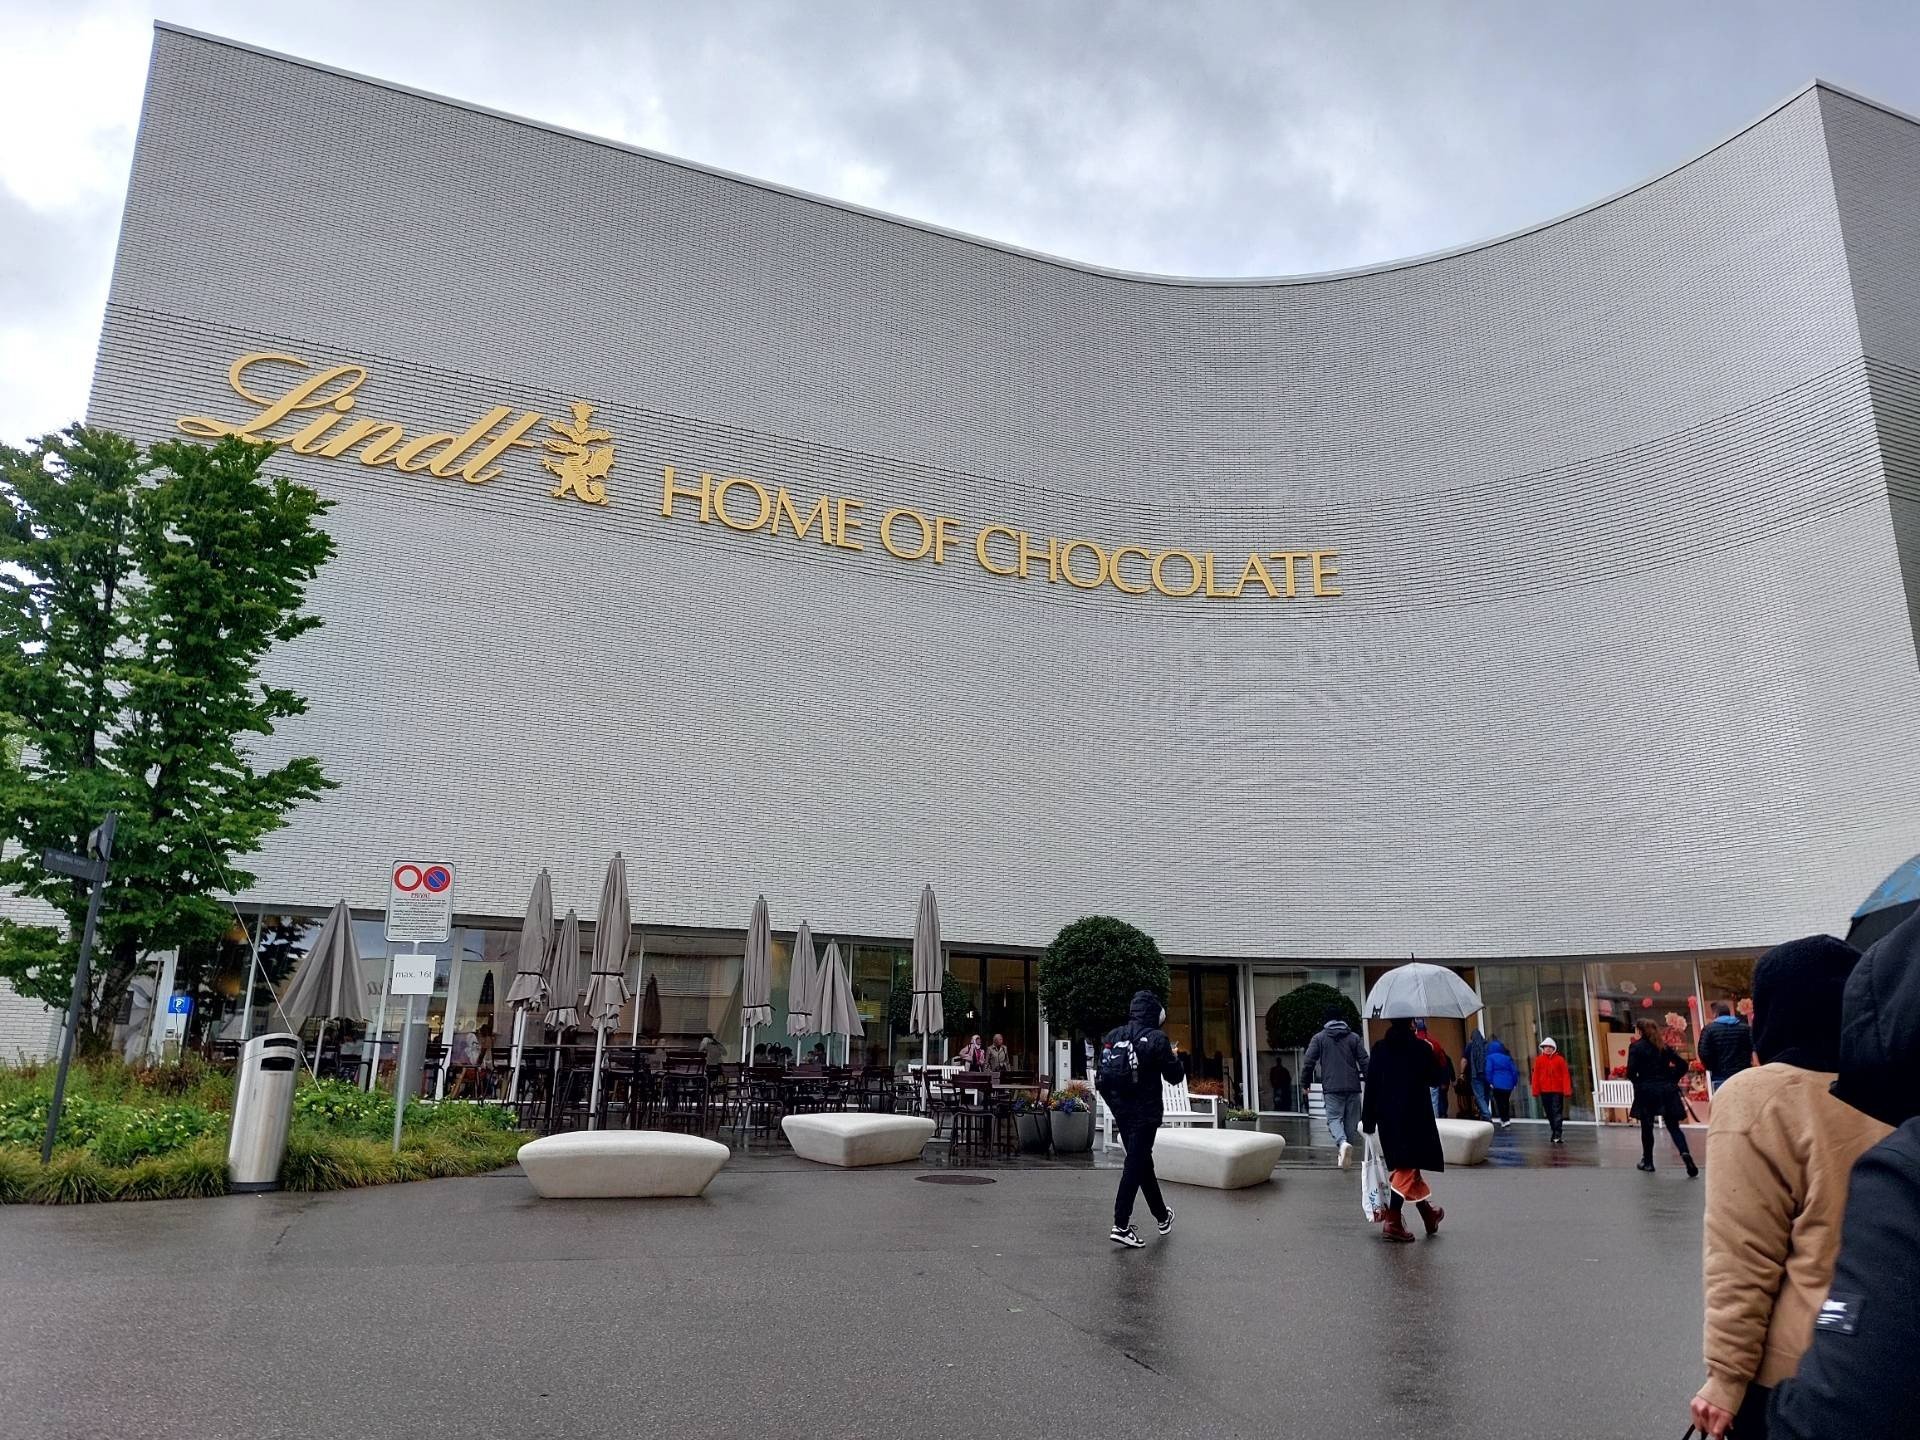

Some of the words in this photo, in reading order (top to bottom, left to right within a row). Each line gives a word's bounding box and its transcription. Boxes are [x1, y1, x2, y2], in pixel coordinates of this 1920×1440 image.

[176, 352, 543, 484] Lindt
[661, 465, 865, 550] HOME
[880, 508, 960, 564] OF
[975, 525, 1343, 597] CHOCOLATE
